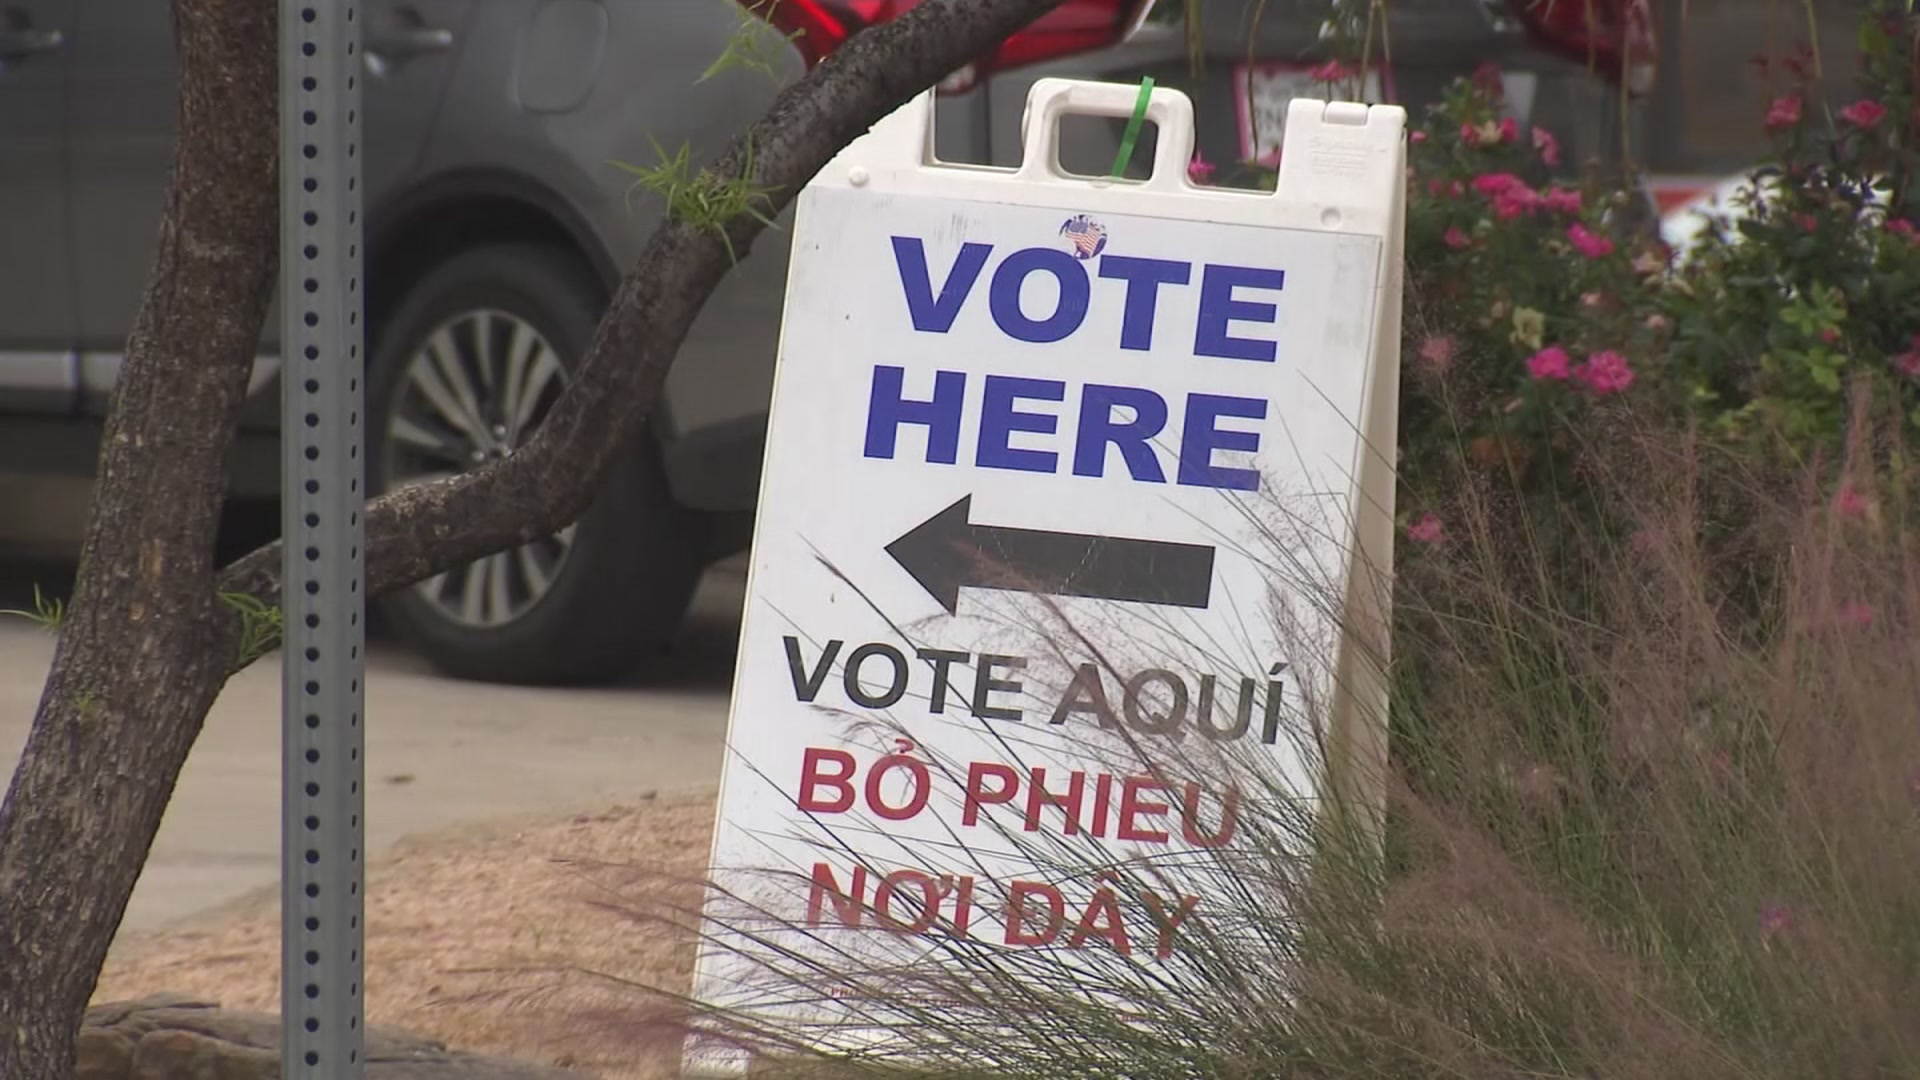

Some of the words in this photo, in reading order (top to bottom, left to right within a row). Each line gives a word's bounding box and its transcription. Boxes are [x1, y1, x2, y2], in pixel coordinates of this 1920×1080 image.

[891, 236, 1285, 362] VOTE
[864, 365, 1268, 491] HERE
[783, 636, 1027, 721] VOTE
[1050, 662, 1288, 744] AQUÍ
[797, 738, 931, 820] BỎ
